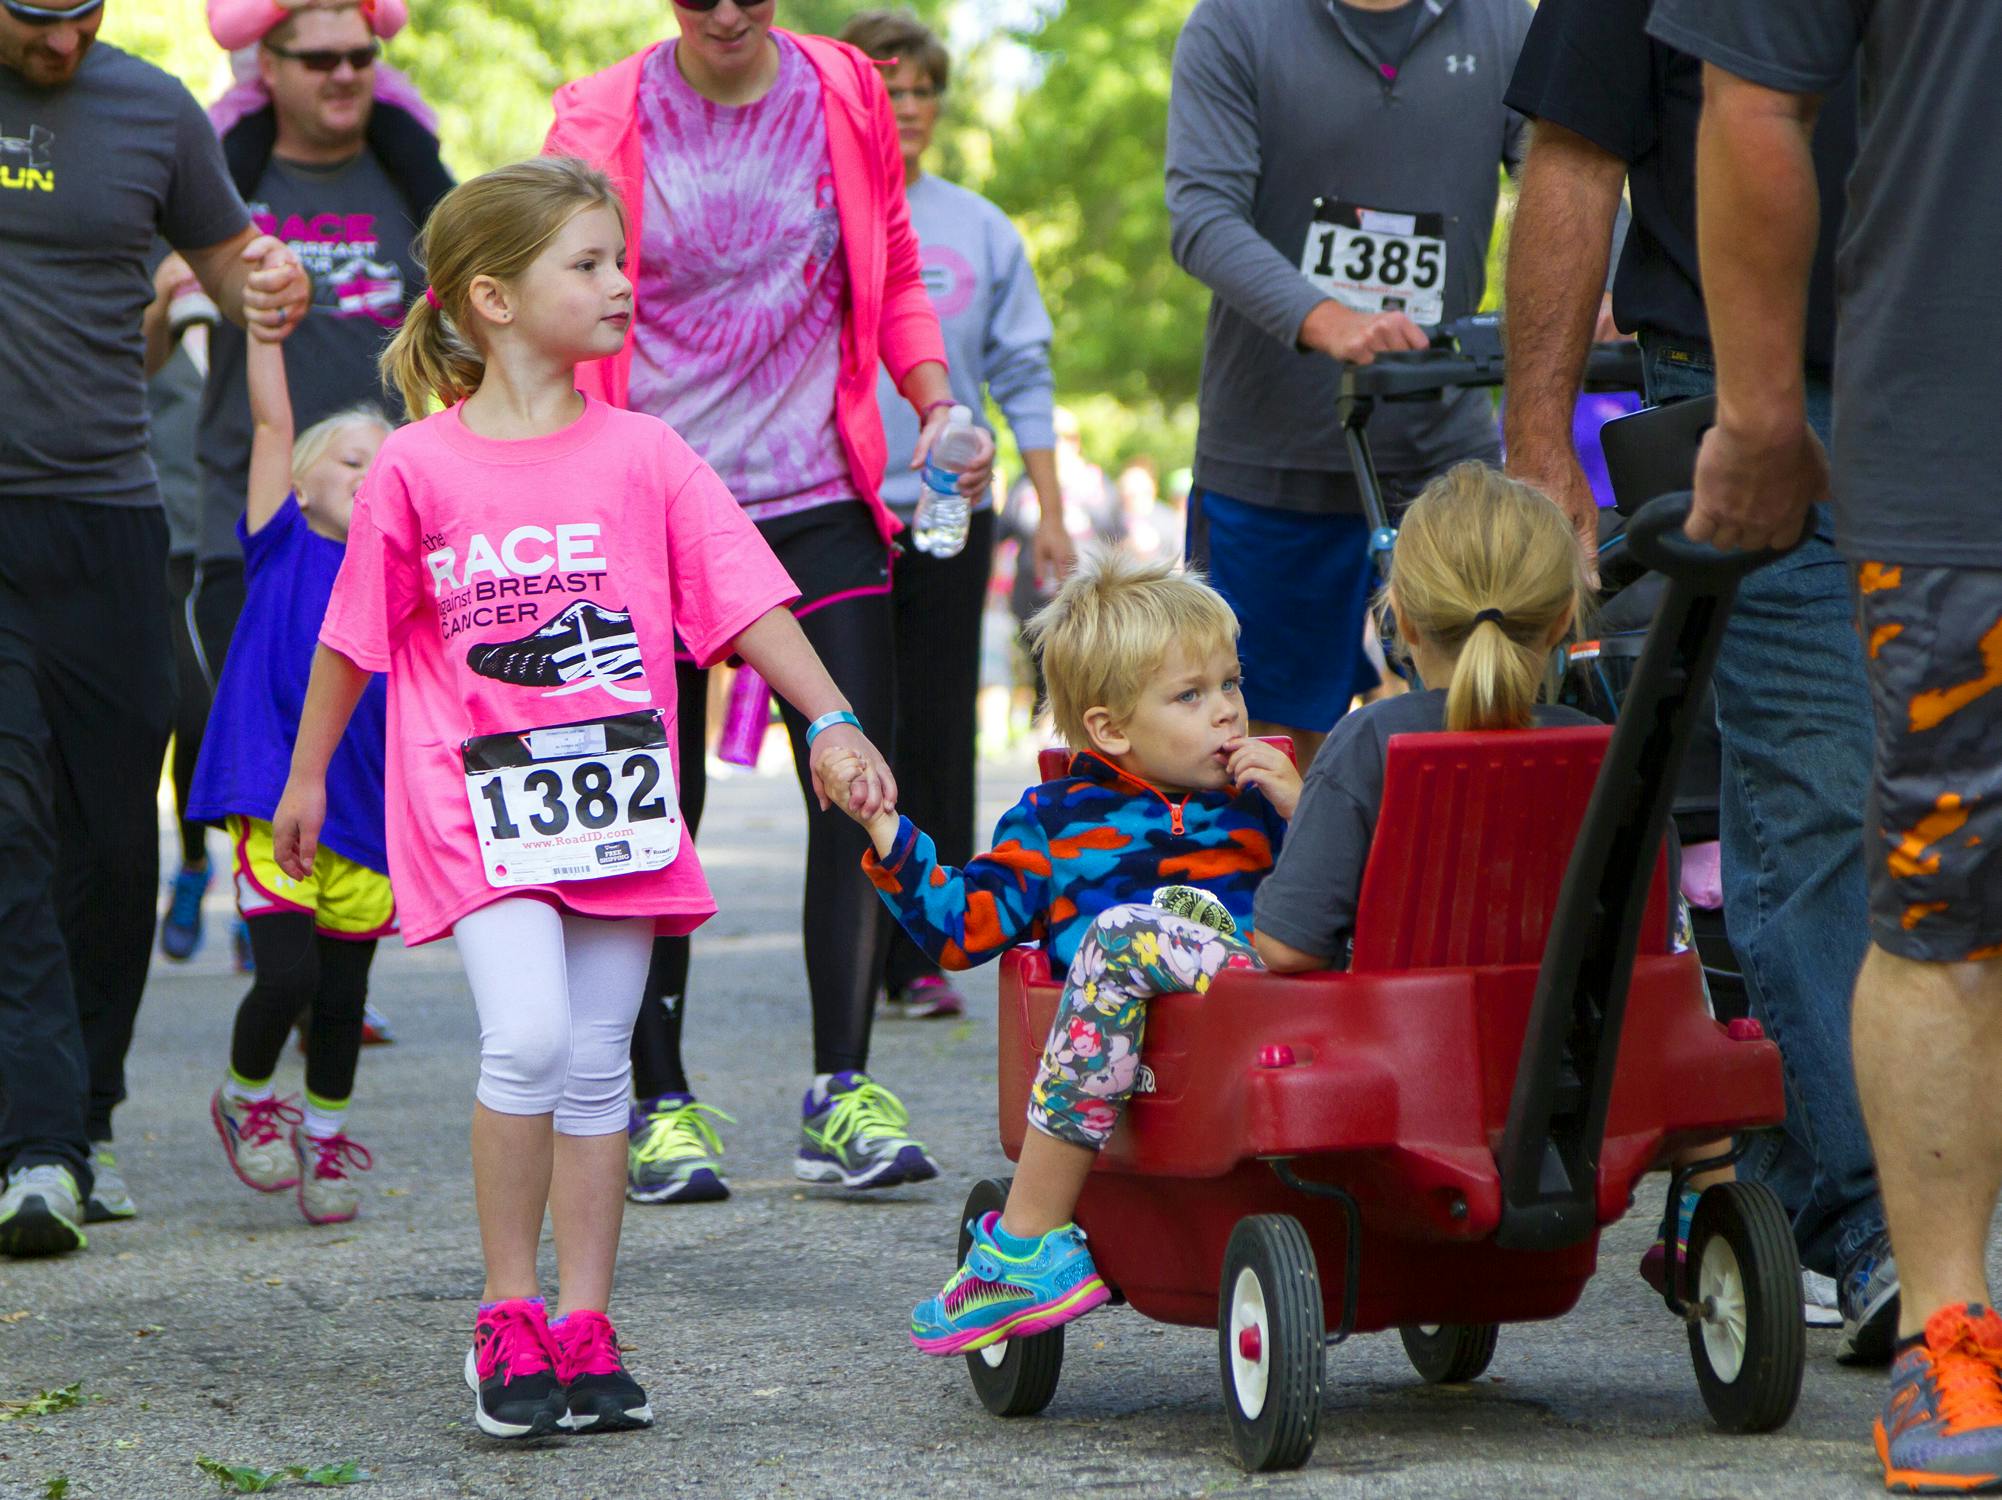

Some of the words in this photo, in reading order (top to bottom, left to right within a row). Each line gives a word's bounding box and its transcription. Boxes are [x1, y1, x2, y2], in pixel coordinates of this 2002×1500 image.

[1313, 230, 1440, 288] 1385
[422, 533, 446, 551] the
[427, 523, 607, 597] RACE
[476, 572, 607, 602] BREAST
[441, 602, 538, 640] CANCER
[481, 754, 667, 839] 1382
[522, 827, 635, 850] www.RoadID.com
[604, 849, 623, 858] FREE
